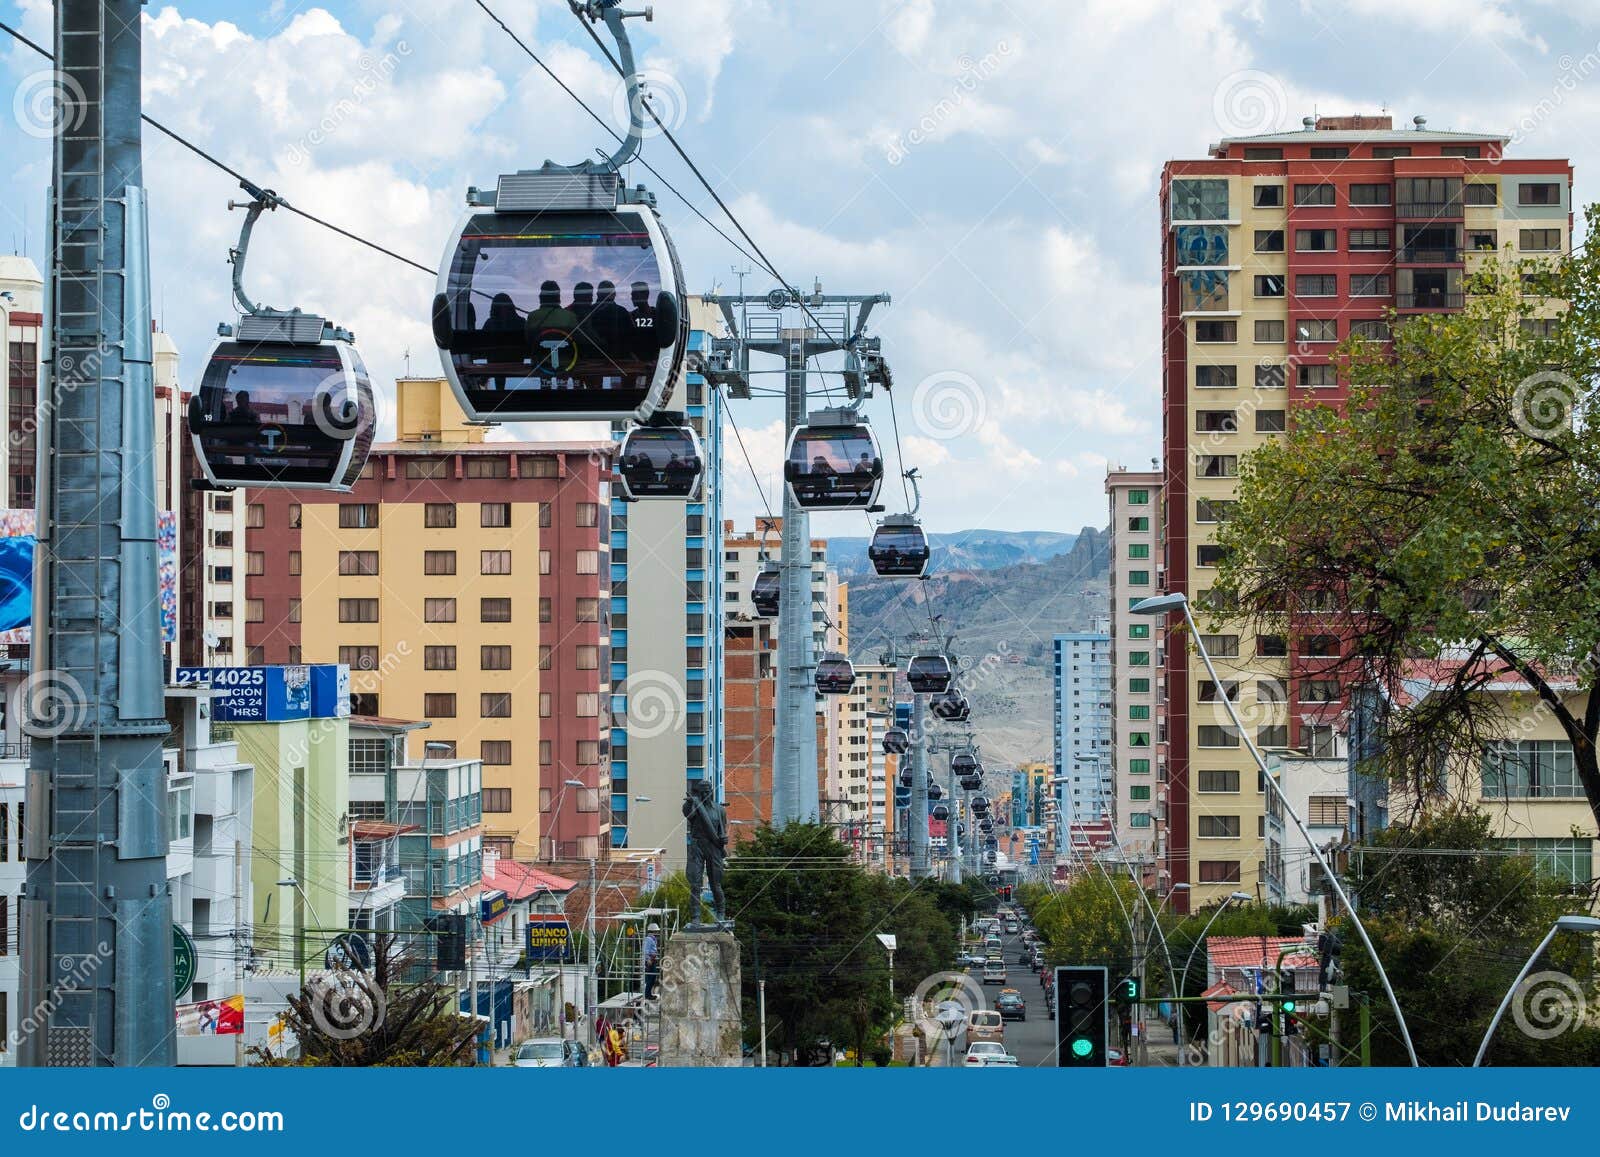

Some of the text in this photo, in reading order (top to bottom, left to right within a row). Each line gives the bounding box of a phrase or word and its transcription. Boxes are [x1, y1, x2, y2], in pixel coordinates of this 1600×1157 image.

[634, 317, 653, 328] 122
[179, 669, 264, 685] 2114025
[230, 686, 262, 696] CIÓN
[248, 698, 263, 706] 24
[531, 927, 567, 938] BANCO
[175, 953, 188, 966] IA
[1128, 982, 1137, 997] 3
